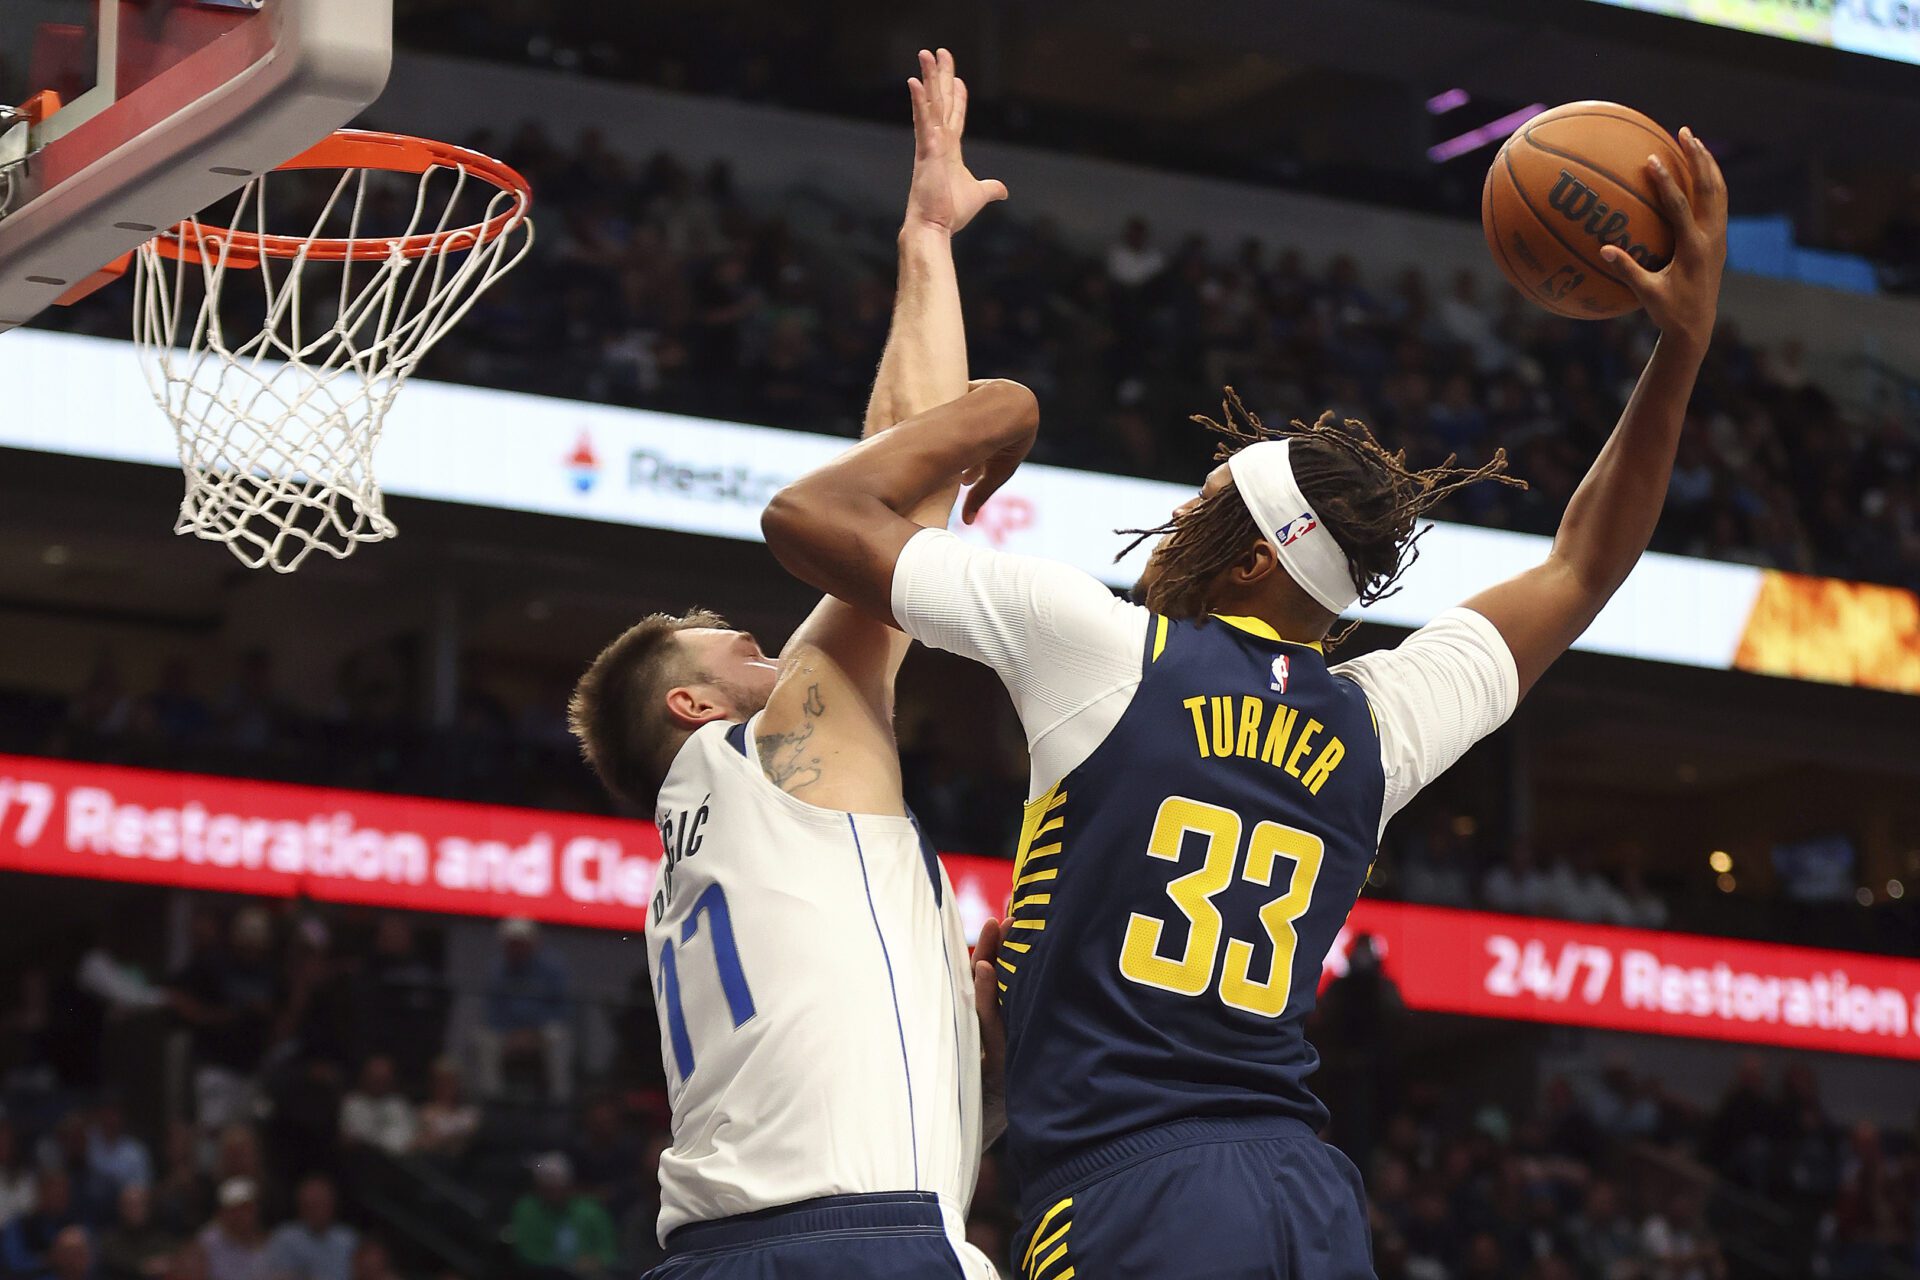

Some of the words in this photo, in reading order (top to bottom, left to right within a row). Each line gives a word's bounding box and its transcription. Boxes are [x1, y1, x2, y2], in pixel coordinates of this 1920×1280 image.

[1548, 168, 1662, 269] Wilso
[629, 450, 787, 503] Resto
[1182, 695, 1346, 796] TURNER
[66, 787, 429, 885] Restoration
[434, 833, 553, 897] and
[561, 836, 657, 907] Cle
[1119, 795, 1325, 1018] 33
[657, 880, 757, 1084] 77
[1485, 936, 1613, 1003] 24/7
[1621, 950, 1908, 1036] Restoration
